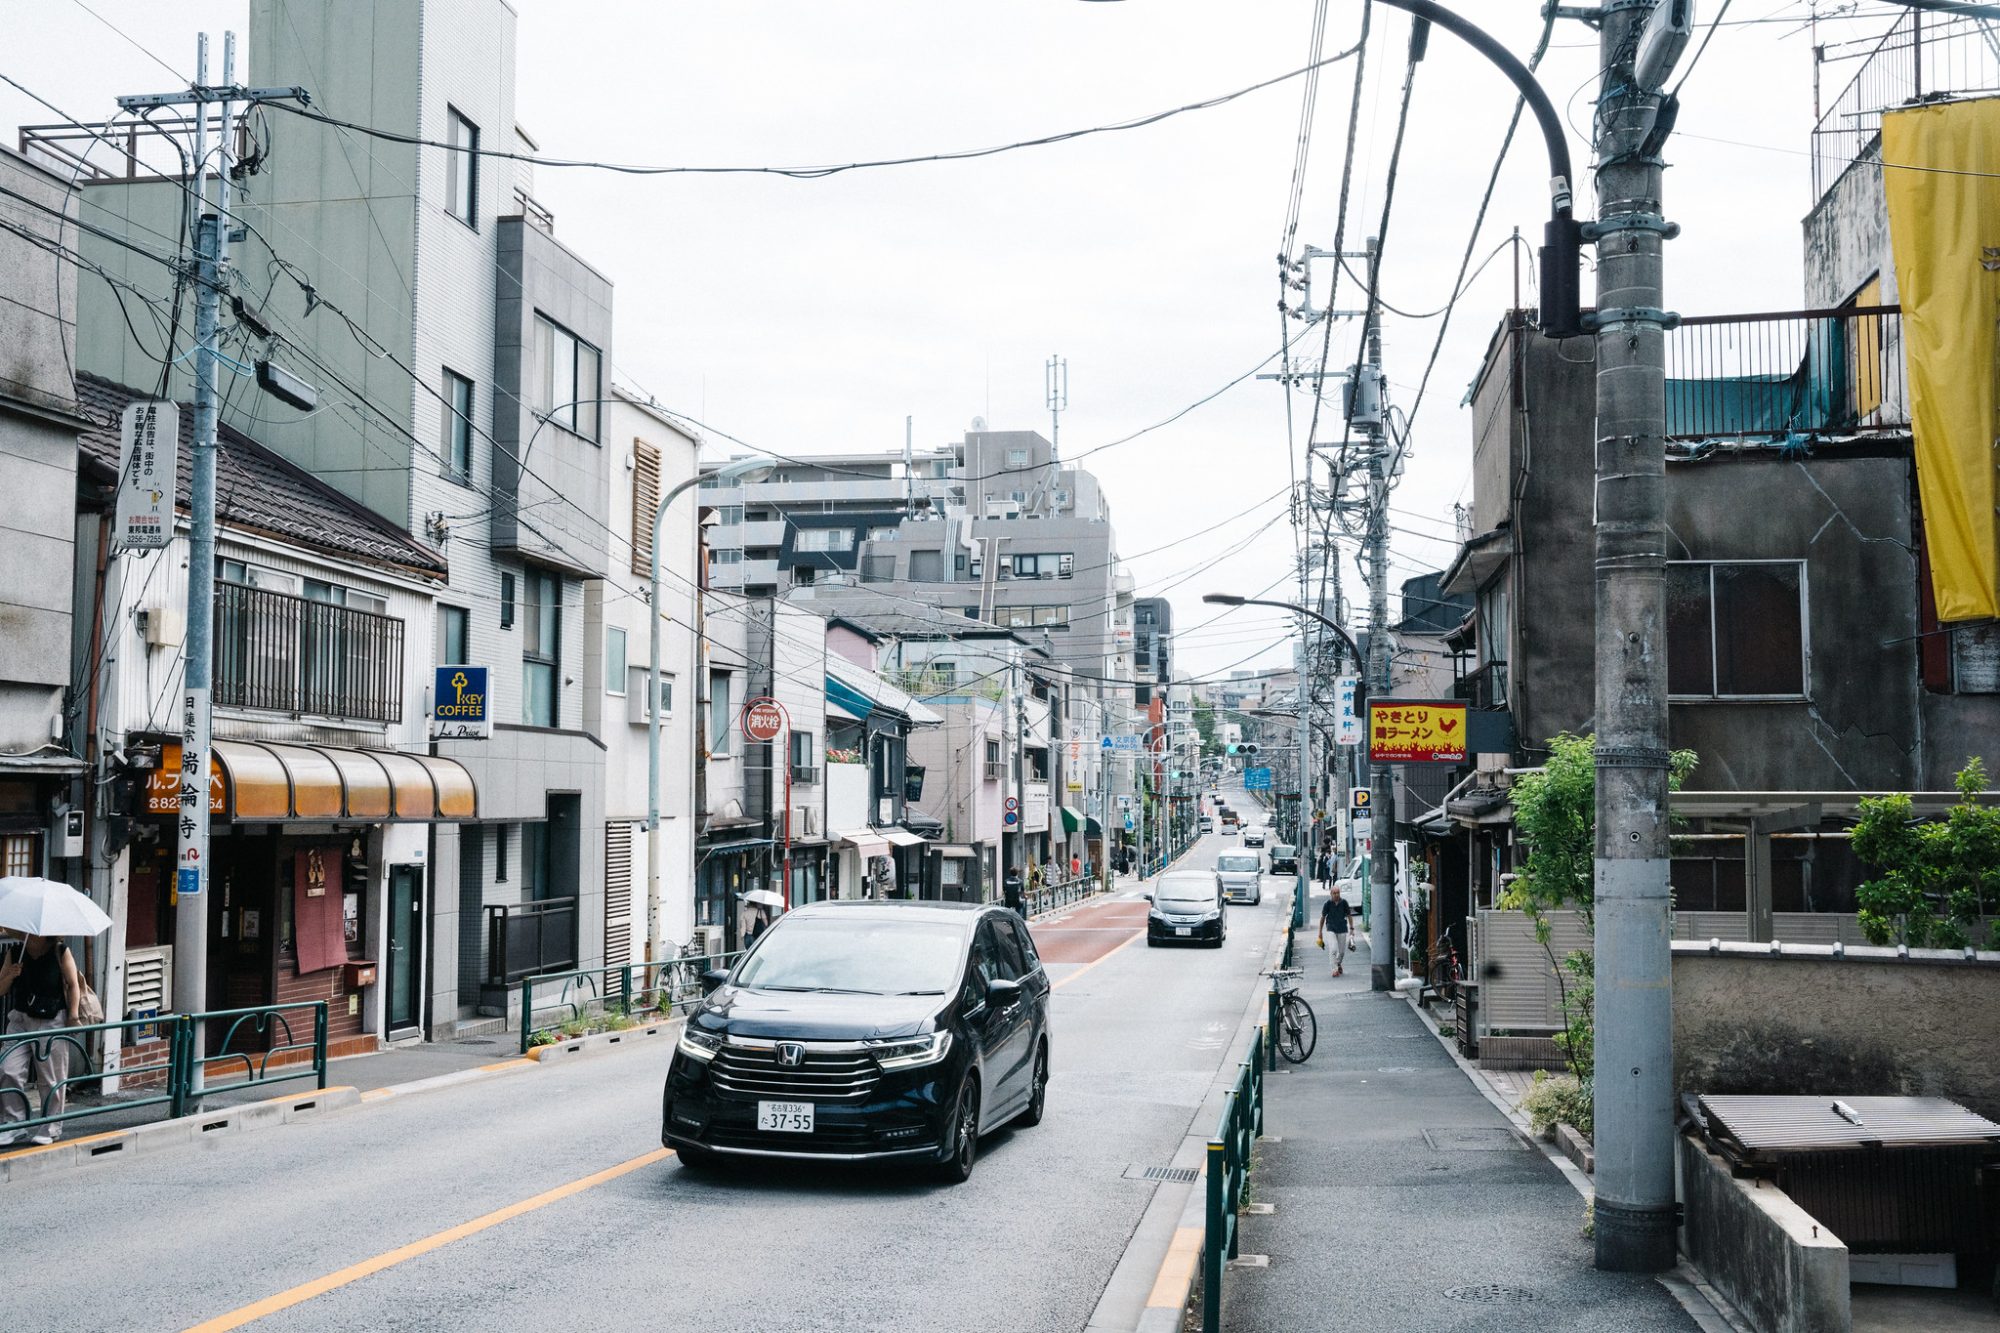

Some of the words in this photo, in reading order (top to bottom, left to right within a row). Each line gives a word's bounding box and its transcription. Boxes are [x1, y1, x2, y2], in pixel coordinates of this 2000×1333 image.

[127, 535, 162, 543] 3256-7255
[461, 694, 484, 705] KEY
[436, 705, 483, 716] COFFEE
[1375, 710, 1428, 724] やきとり
[184, 696, 196, 743] 日蓮宗
[751, 714, 780, 729] 消火栓
[761, 1116, 769, 1125] た
[770, 1114, 811, 1130] 37-55
